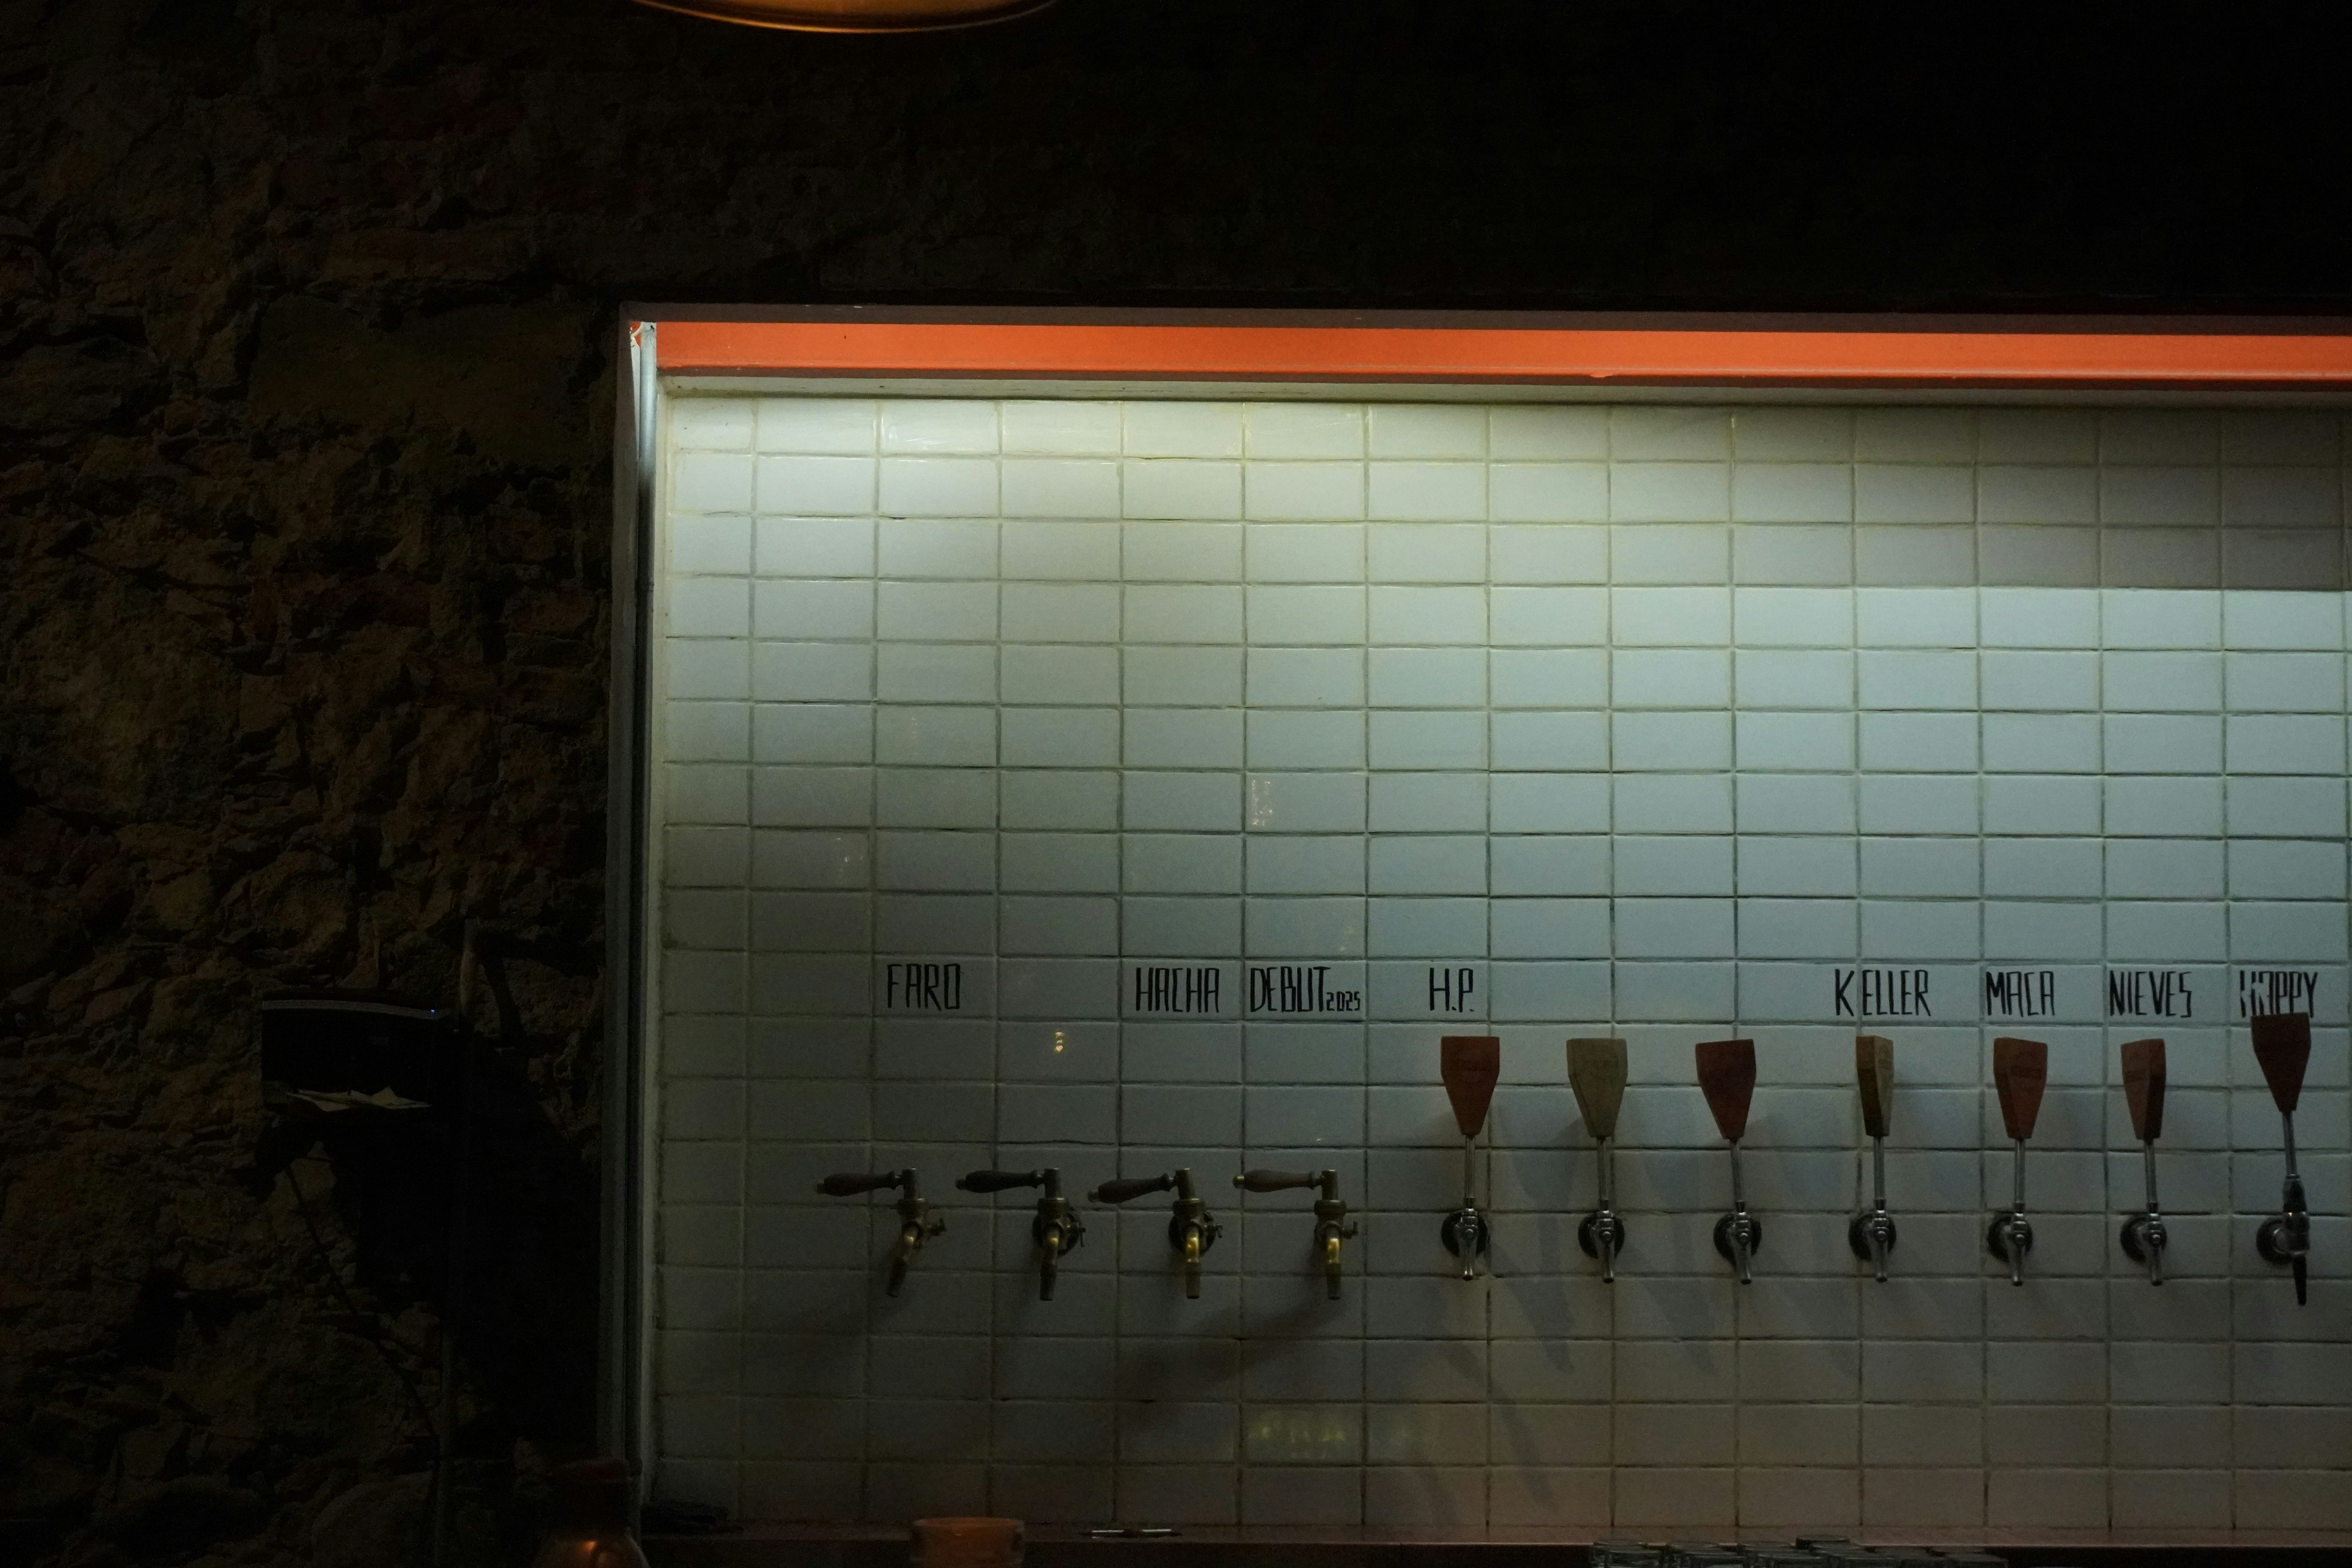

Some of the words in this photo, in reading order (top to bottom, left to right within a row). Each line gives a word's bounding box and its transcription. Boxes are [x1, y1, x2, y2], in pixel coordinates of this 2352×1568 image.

[887, 964, 960, 1011] FARO
[1136, 967, 1220, 1013] HACHA
[1250, 966, 1330, 1013] DEBUT
[1326, 991, 1360, 1011] 2025
[1429, 967, 1474, 1013] H.P.
[1835, 969, 1931, 1016] KELLER
[1985, 971, 2055, 1017] MACA
[2109, 970, 2192, 1018] NIEVES
